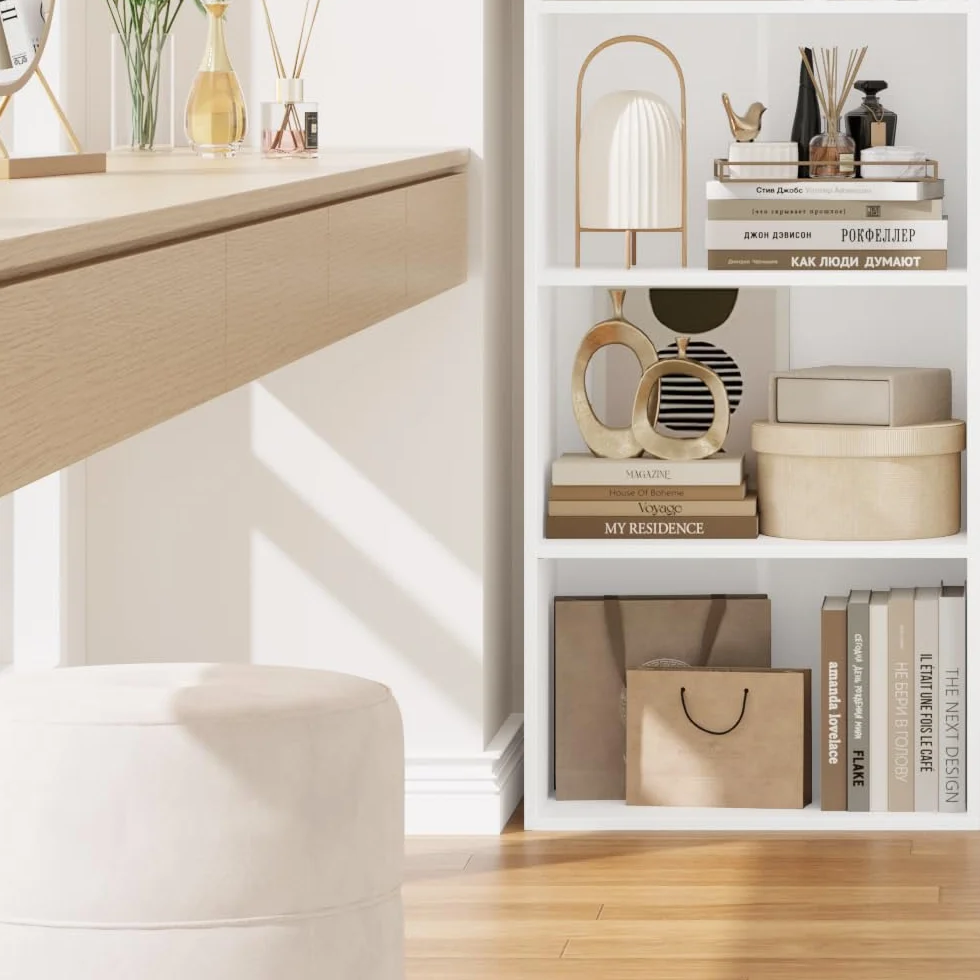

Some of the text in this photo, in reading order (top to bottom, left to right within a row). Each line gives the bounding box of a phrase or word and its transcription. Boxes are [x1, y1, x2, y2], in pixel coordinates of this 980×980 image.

[756, 186, 803, 195] Стив Джобс
[744, 231, 812, 240] ДЖОН ДЭВИСОН
[841, 228, 917, 243] РОКФЕЛЛЕР
[791, 256, 818, 267] КАК
[819, 256, 859, 269] ЛЮДИ
[864, 256, 922, 269] ДУМАЮТ
[625, 469, 673, 480] MAGAZINE
[609, 488, 649, 497] House Of
[604, 522, 705, 535] MY RESIDENCE
[827, 661, 841, 765] amanda lovelace
[920, 653, 935, 772] IL ÉTAIT UNE FOIS LE CAFÉ
[894, 662, 909, 783] НЕ БЕРИ В ГОЛОВУ
[944, 667, 959, 804] THE NEXT DESIGN
[852, 749, 865, 787] FLAKE
